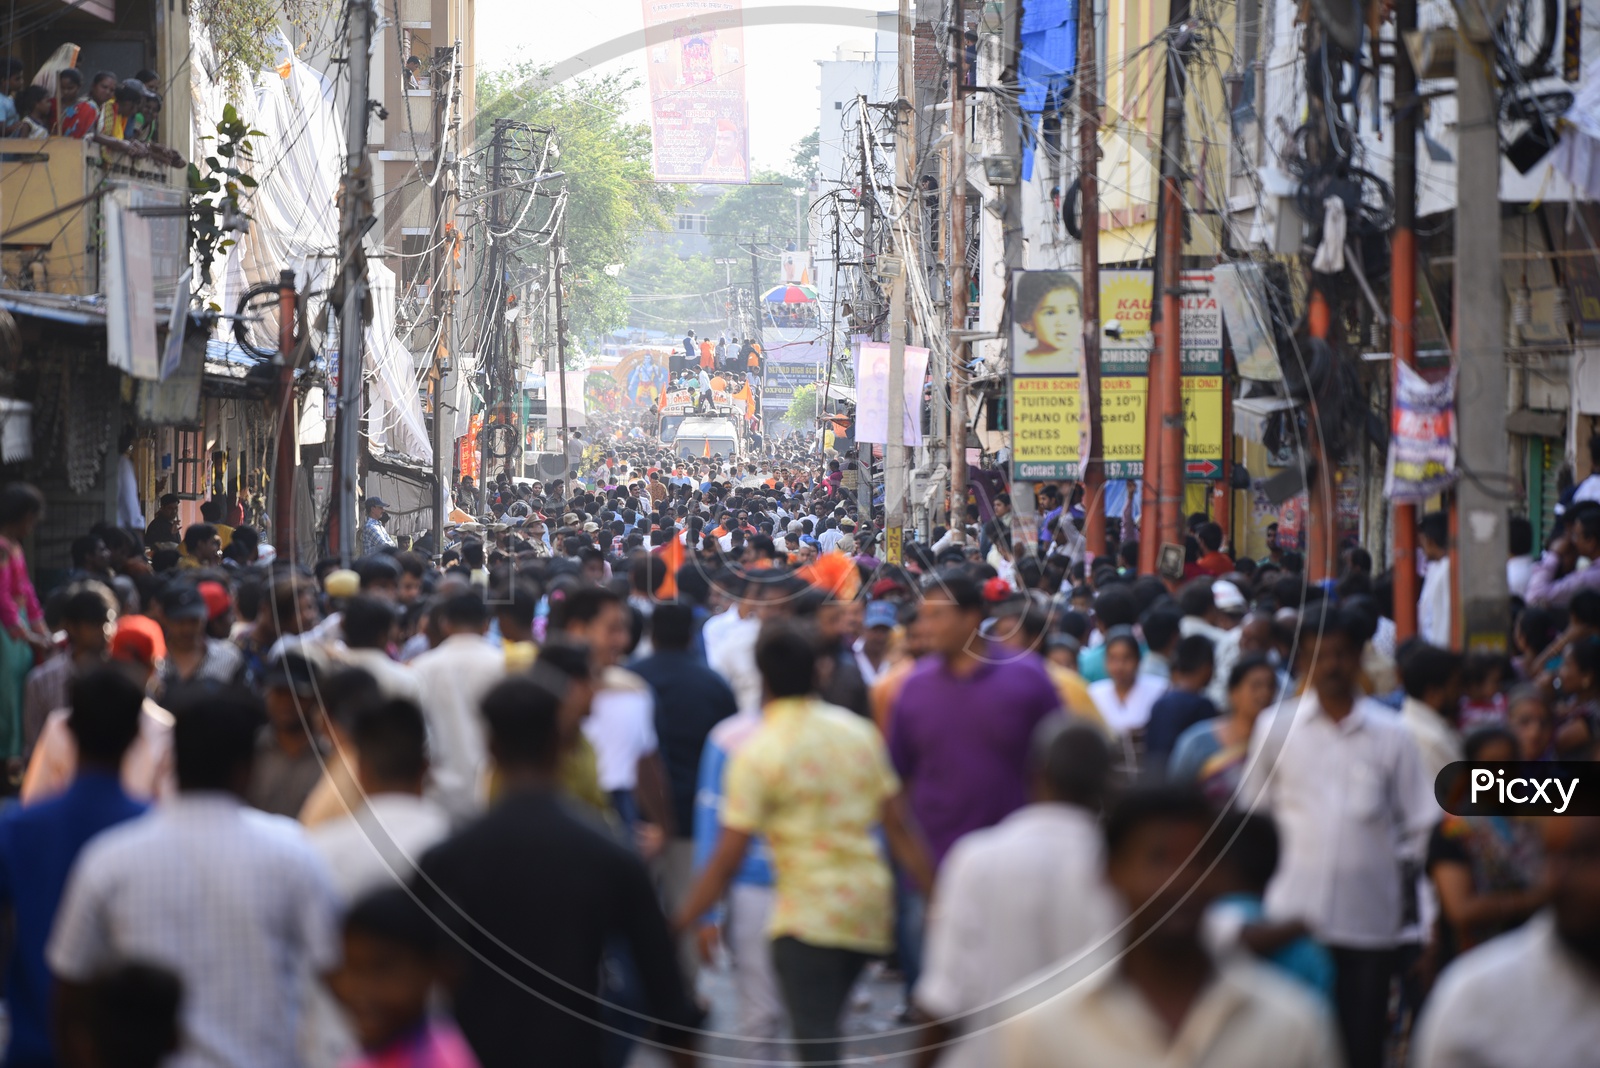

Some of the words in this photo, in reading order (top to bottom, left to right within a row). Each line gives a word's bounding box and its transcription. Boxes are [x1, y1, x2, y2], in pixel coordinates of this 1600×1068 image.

[1100, 350, 1149, 363] DMISSIO
[1188, 350, 1218, 362] OPEN
[1018, 380, 1049, 390] AFTER
[1053, 379, 1080, 389] SCHO
[1103, 380, 1131, 389] OURS
[1021, 397, 1074, 406] TUITIONS
[1021, 413, 1061, 423] PIANO
[1021, 429, 1060, 439] CHESS
[1022, 446, 1052, 455] MATHS
[1020, 464, 1056, 477] Contact
